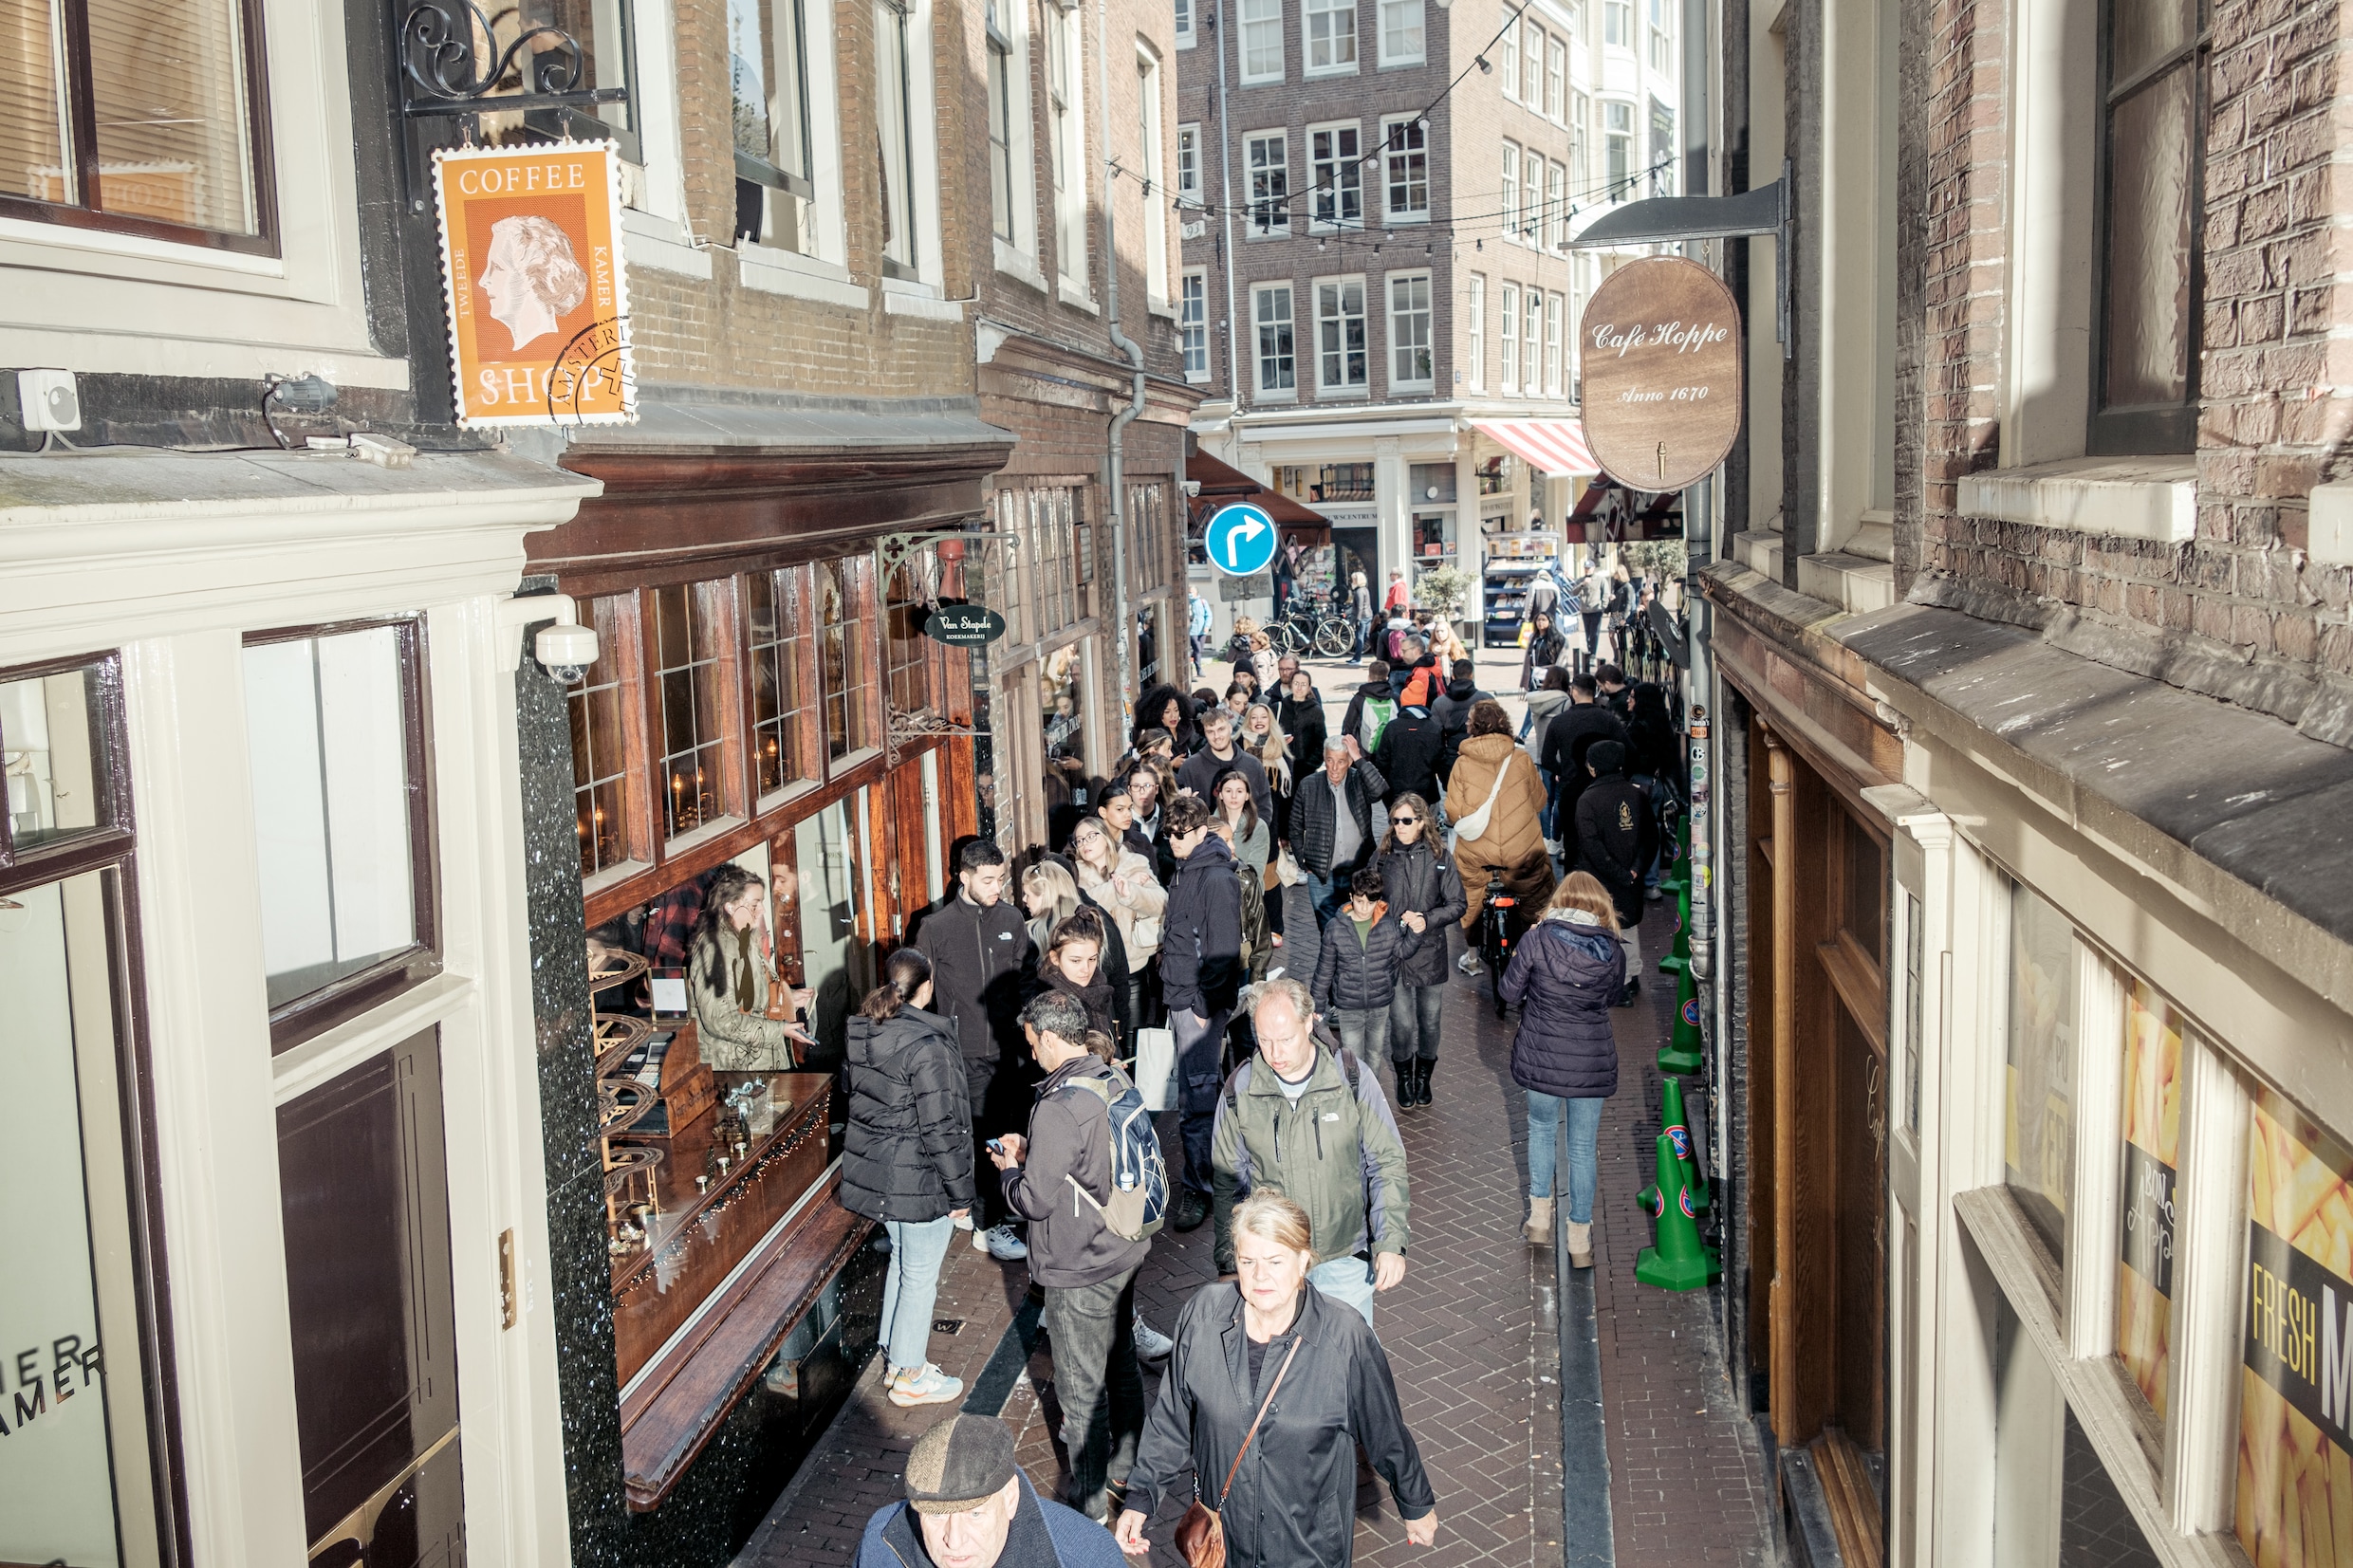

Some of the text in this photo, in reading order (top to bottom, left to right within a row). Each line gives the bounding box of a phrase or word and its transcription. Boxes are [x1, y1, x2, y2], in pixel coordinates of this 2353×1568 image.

[459, 164, 585, 194] COFFEE
[1187, 222, 1199, 237] 93
[454, 249, 470, 318] TWEEDE
[594, 246, 612, 308] KAMER
[1592, 322, 1728, 359] Café Hoppe
[479, 367, 603, 405] SHOP
[1617, 386, 1709, 403] Anno 1670
[938, 616, 992, 634] Van Stapele
[2144, 1160, 2167, 1210] BON
[2253, 1262, 2315, 1386] FRESH
